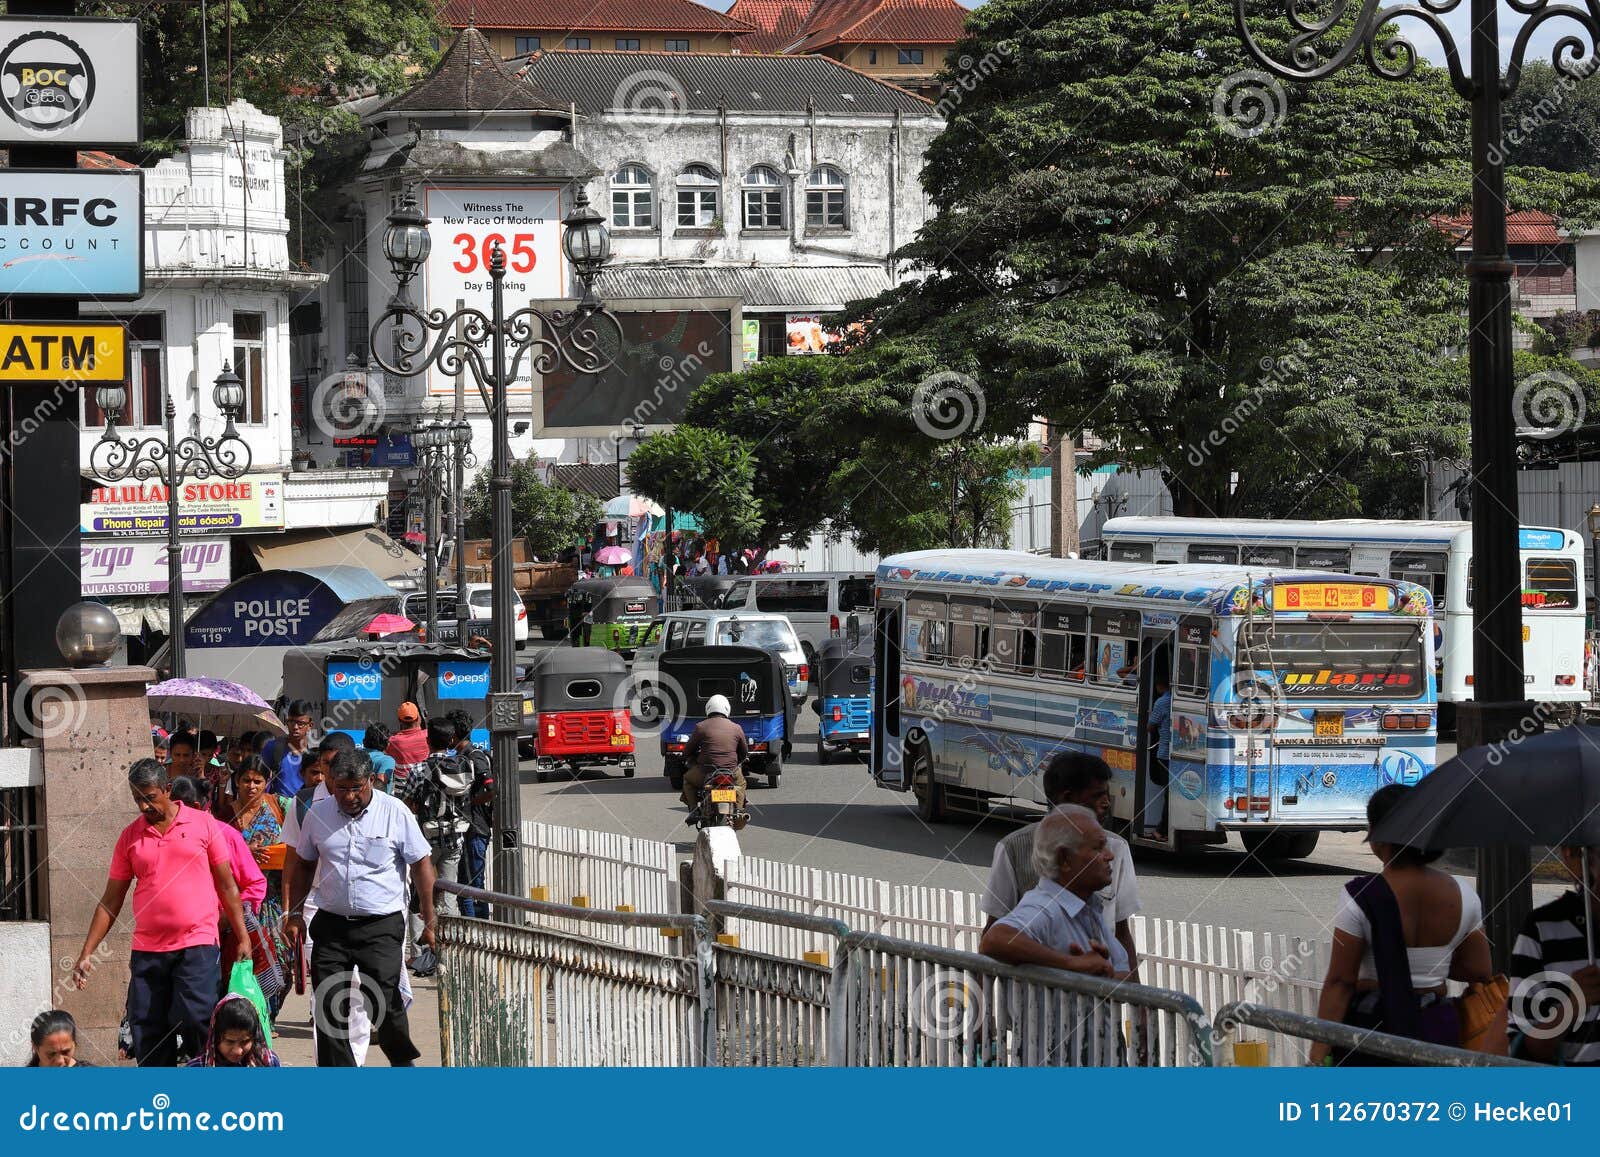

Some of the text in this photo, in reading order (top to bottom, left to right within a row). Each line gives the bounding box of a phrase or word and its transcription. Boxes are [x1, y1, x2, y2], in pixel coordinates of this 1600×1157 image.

[22, 68, 67, 87] BOC
[229, 175, 269, 191] RESURANT
[0, 198, 118, 227] RFC
[463, 203, 524, 212] Witness The
[443, 216, 544, 225] New Face Of Modern
[452, 233, 537, 274] 365
[464, 281, 526, 292] Day Bnking
[2, 335, 96, 371] ATM
[184, 483, 252, 502] STORE
[103, 517, 166, 530] Phone Repair
[81, 582, 150, 594] LULAR STORE
[1326, 588, 1338, 602] 42
[234, 599, 310, 618] POLICE
[190, 626, 232, 635] Emergency
[244, 618, 302, 637] POST
[201, 633, 223, 644] 119
